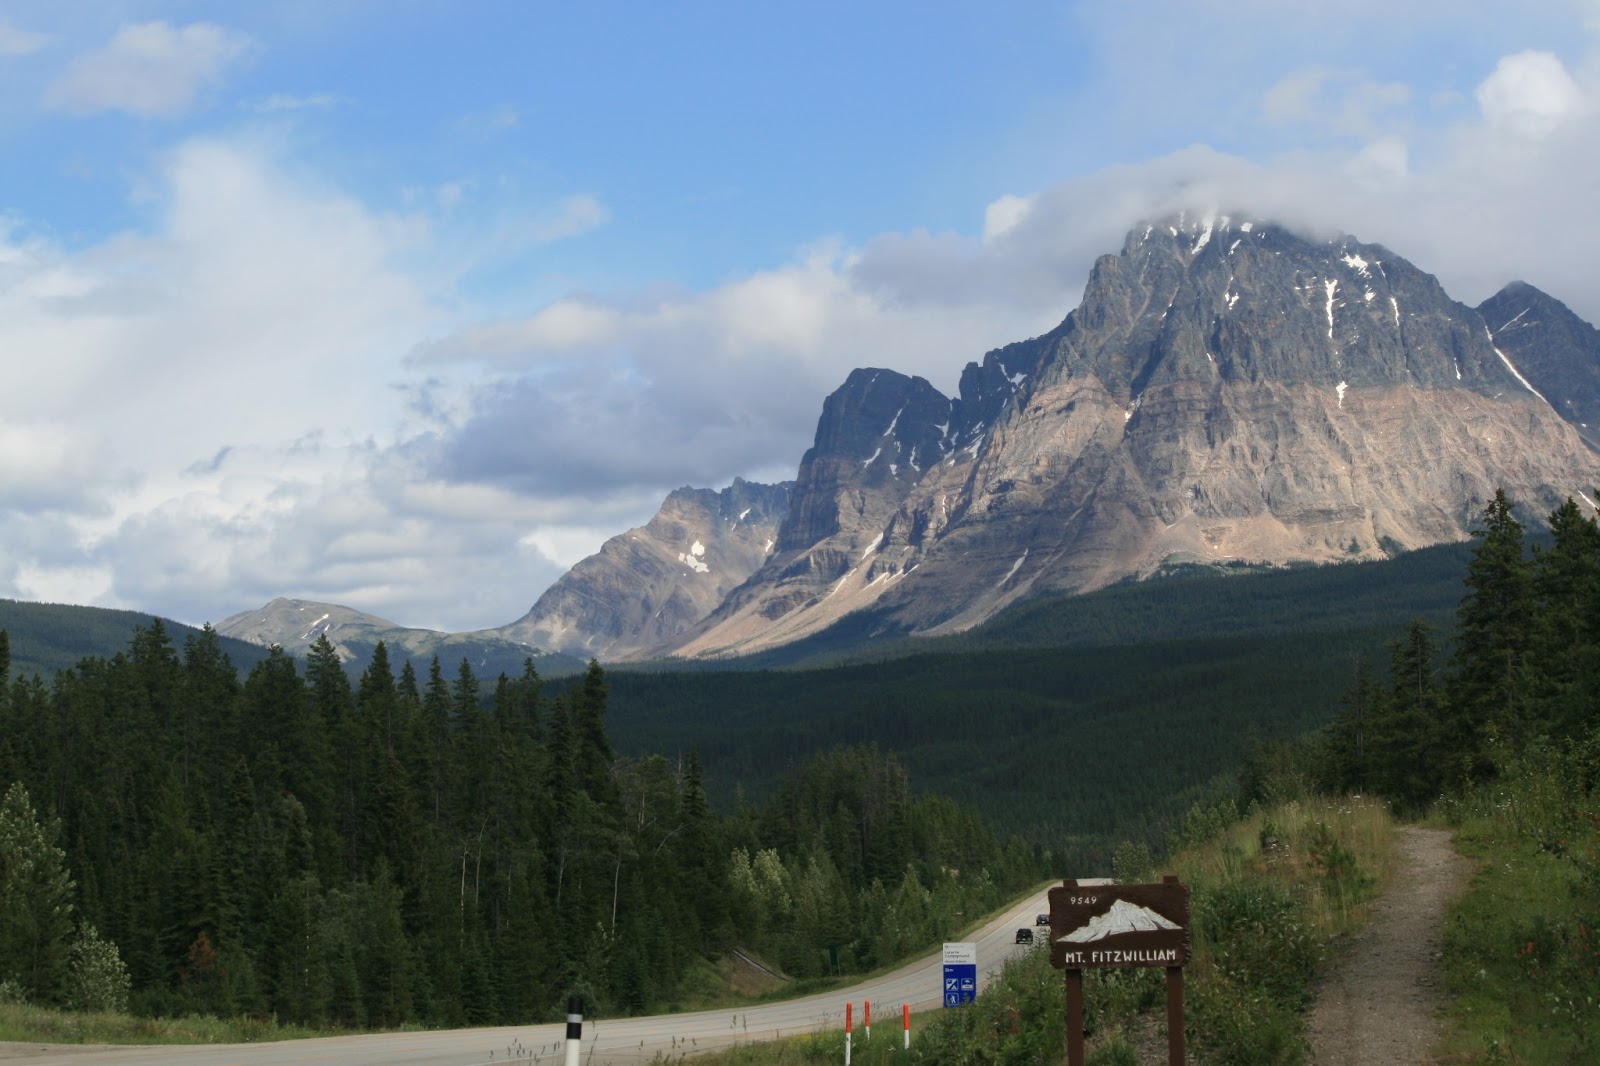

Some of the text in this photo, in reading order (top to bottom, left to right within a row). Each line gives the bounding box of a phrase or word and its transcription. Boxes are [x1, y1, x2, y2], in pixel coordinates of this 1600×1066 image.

[1070, 896, 1097, 905] 9549
[1065, 949, 1176, 963] MT. FITZWILLIAM
